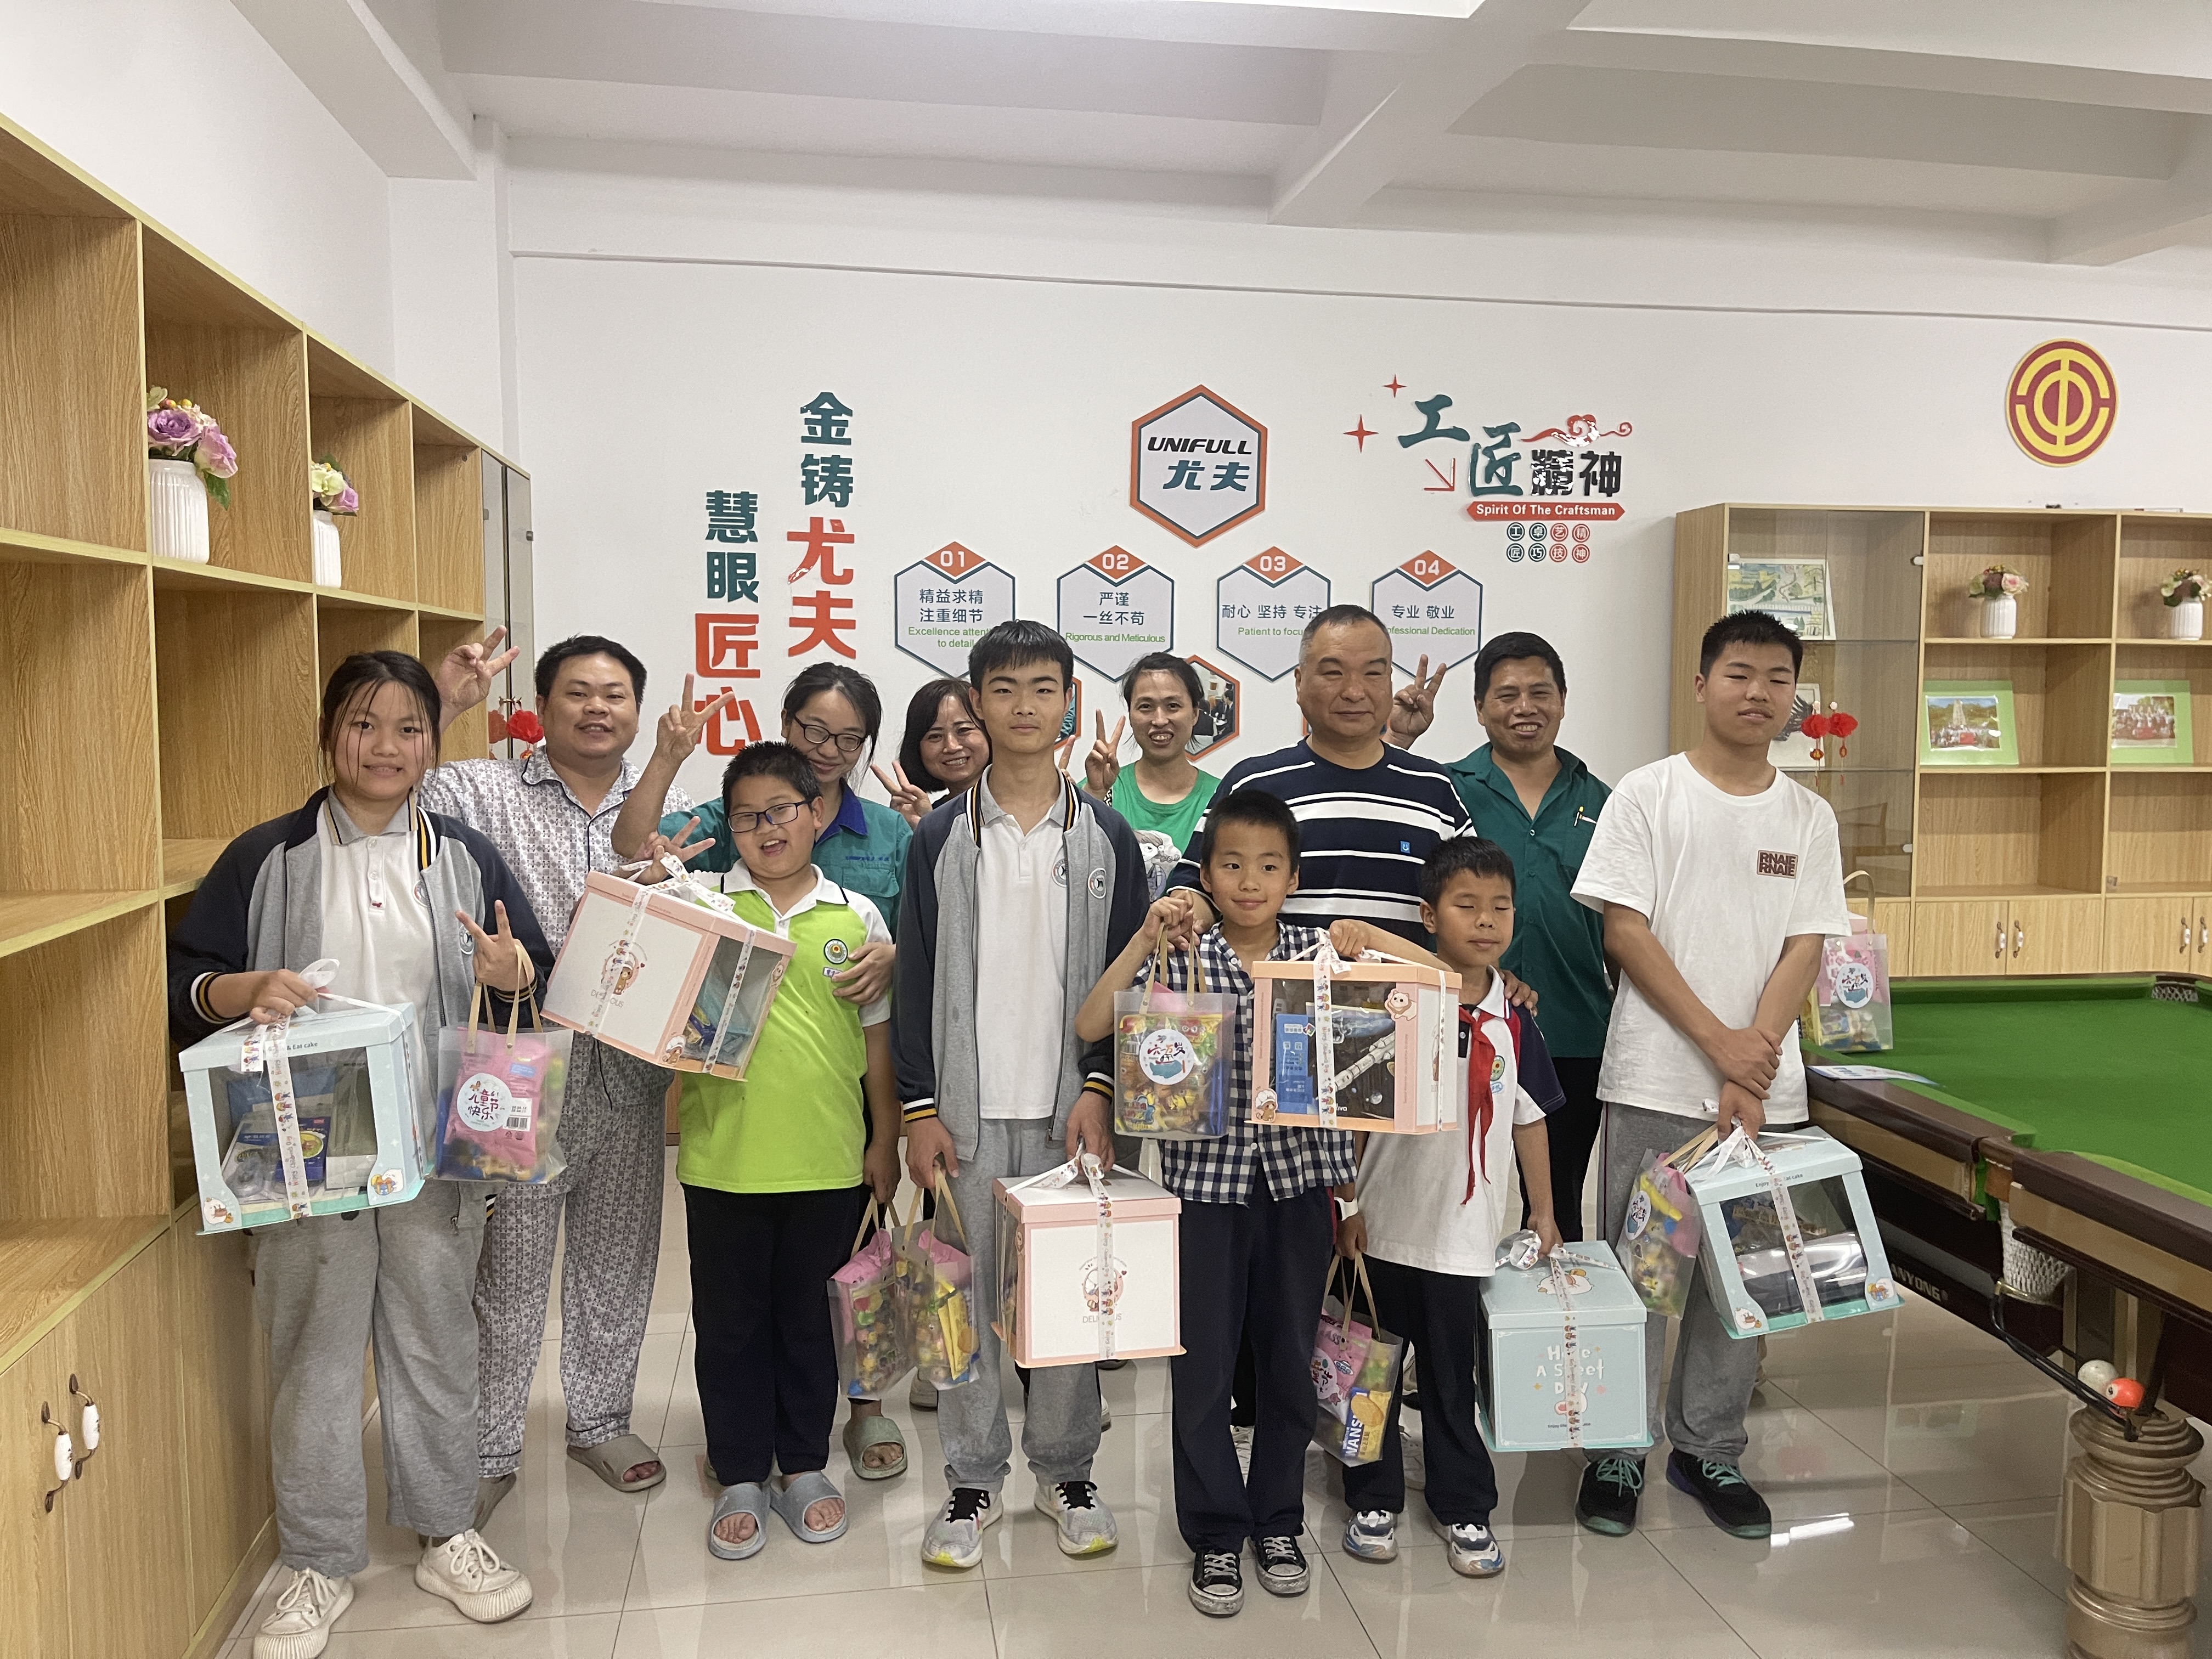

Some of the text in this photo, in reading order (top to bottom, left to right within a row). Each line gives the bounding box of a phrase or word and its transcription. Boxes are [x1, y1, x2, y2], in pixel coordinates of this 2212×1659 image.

[1147, 437, 1252, 455] UNIFULL
[1163, 460, 1250, 492] 尤夫
[1476, 504, 1616, 516] Spirit Of The Craftsman
[787, 392, 856, 659] 金铸尤夫
[940, 550, 965, 567] 01
[1102, 554, 1129, 570] 02
[1260, 556, 1286, 572] 03
[1414, 560, 1440, 575] 04
[919, 589, 983, 604] 精益求精
[1099, 592, 1130, 606] 严谨
[919, 608, 983, 623] 注重细节
[1084, 611, 1145, 625] 一丝不苟
[1222, 605, 1251, 619] 耐心
[1257, 605, 1286, 619] 坚持
[1391, 604, 1454, 619] 专业 敬业
[695, 491, 763, 755] 慧眼匠心
[909, 627, 991, 636] Excellence attent
[1065, 633, 1165, 642] Rigorous and Meticulous
[1238, 627, 1271, 635] Patient
[1284, 627, 1303, 635] focu
[1431, 627, 1475, 635] Dedication
[938, 639, 974, 647] to detail
[1759, 852, 1796, 866] RNAIE
[467, 1105, 494, 1120] 快乐
[1537, 1365, 1547, 1377] A
[1554, 1358, 1604, 1380] Seet
